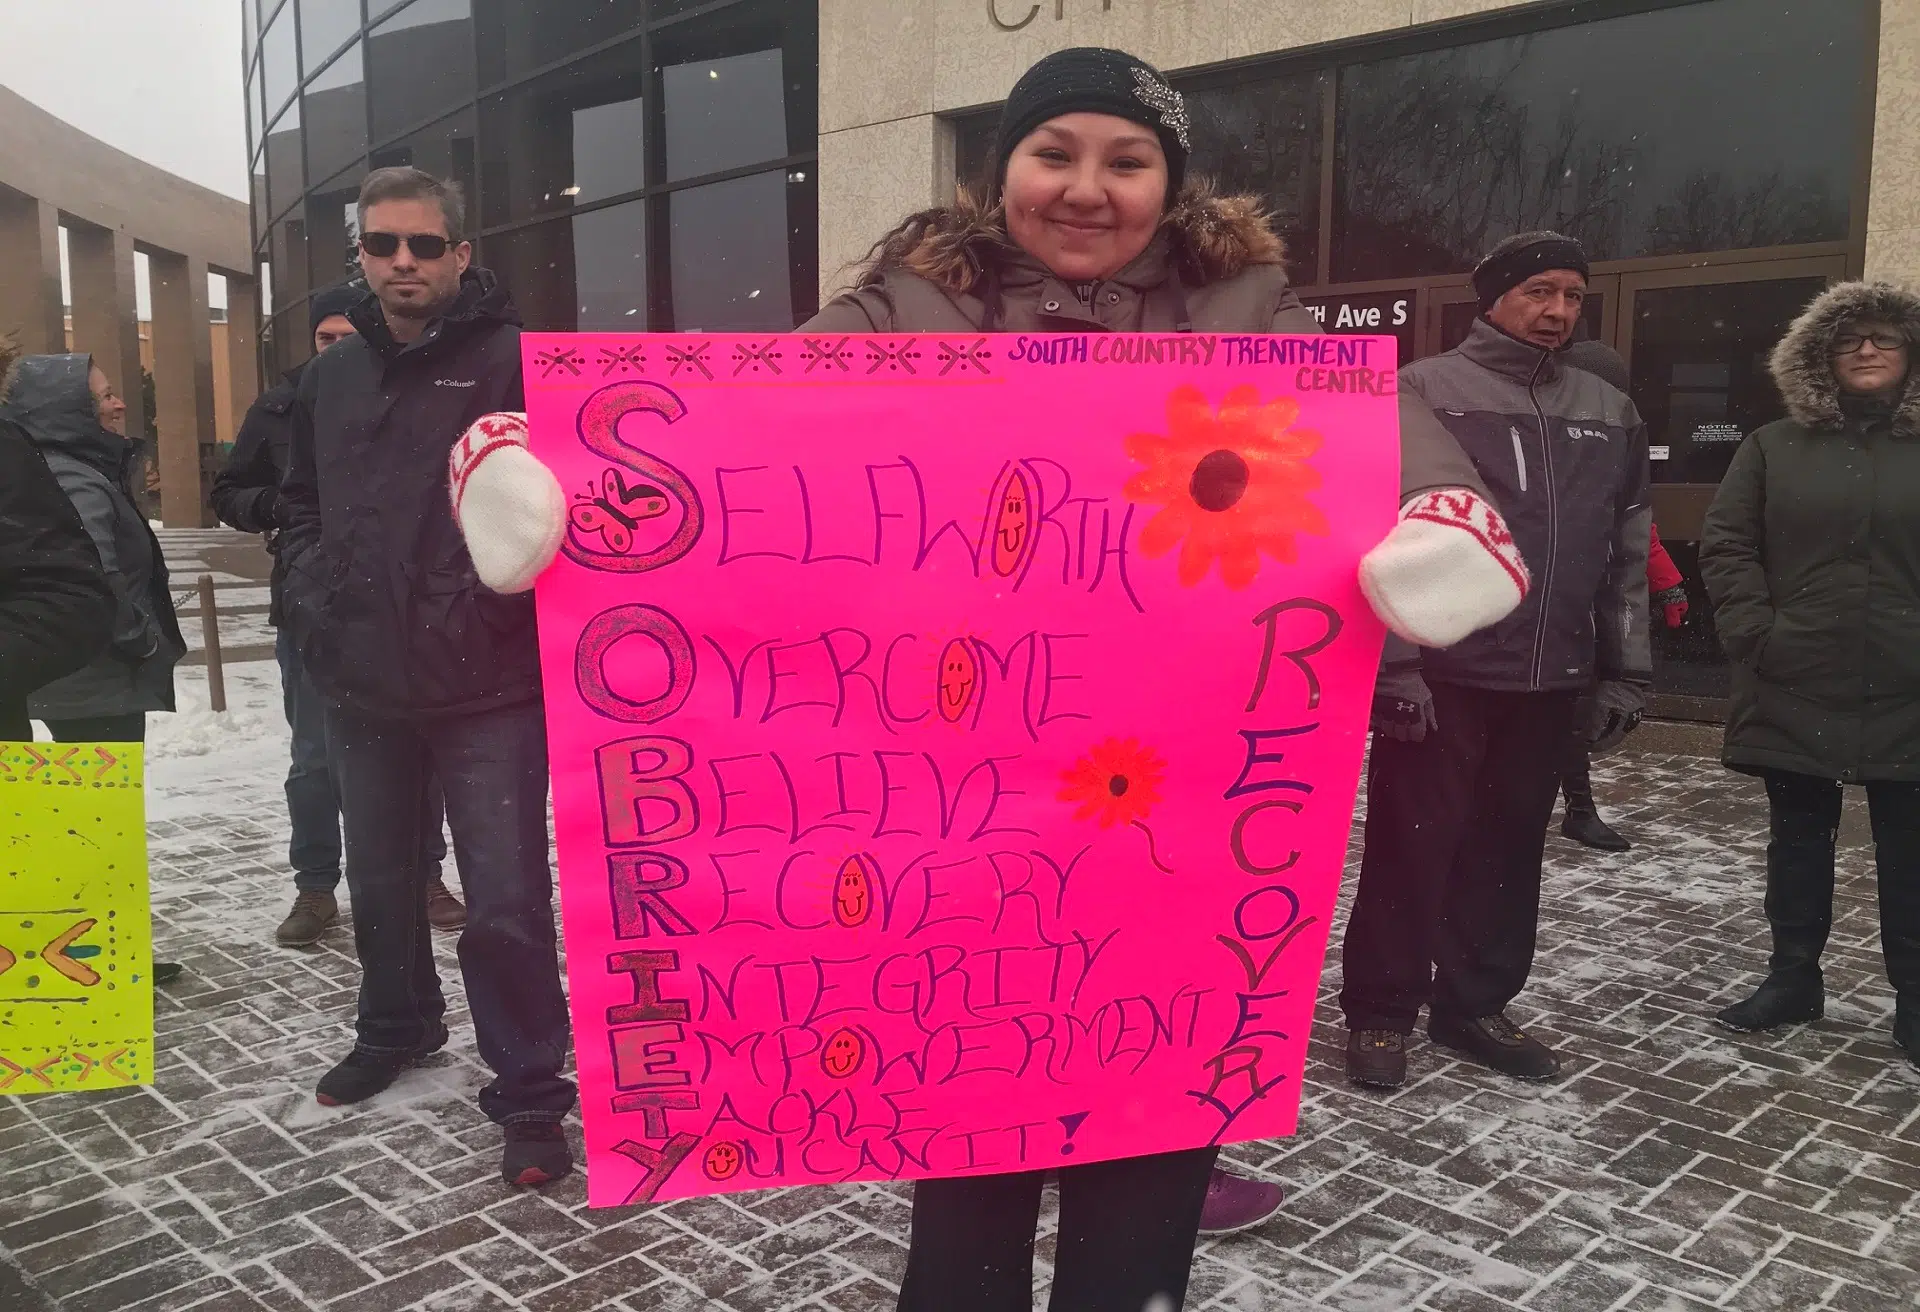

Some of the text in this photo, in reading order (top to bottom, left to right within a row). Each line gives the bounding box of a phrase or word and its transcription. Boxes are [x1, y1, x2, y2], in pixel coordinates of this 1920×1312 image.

[1007, 335, 1089, 366] SOUTH
[1092, 335, 1217, 367] COUNTRY
[1335, 303, 1381, 329] Ave
[1392, 299, 1408, 326] S
[1295, 366, 1398, 397] CENTRE
[573, 602, 1092, 744] OVERCOME
[593, 734, 1041, 849] BELIEVE
[605, 843, 1093, 948] RECOVERY
[604, 927, 1122, 1034] INTEGRITY
[609, 986, 1217, 1092] EMPOWERMENT
